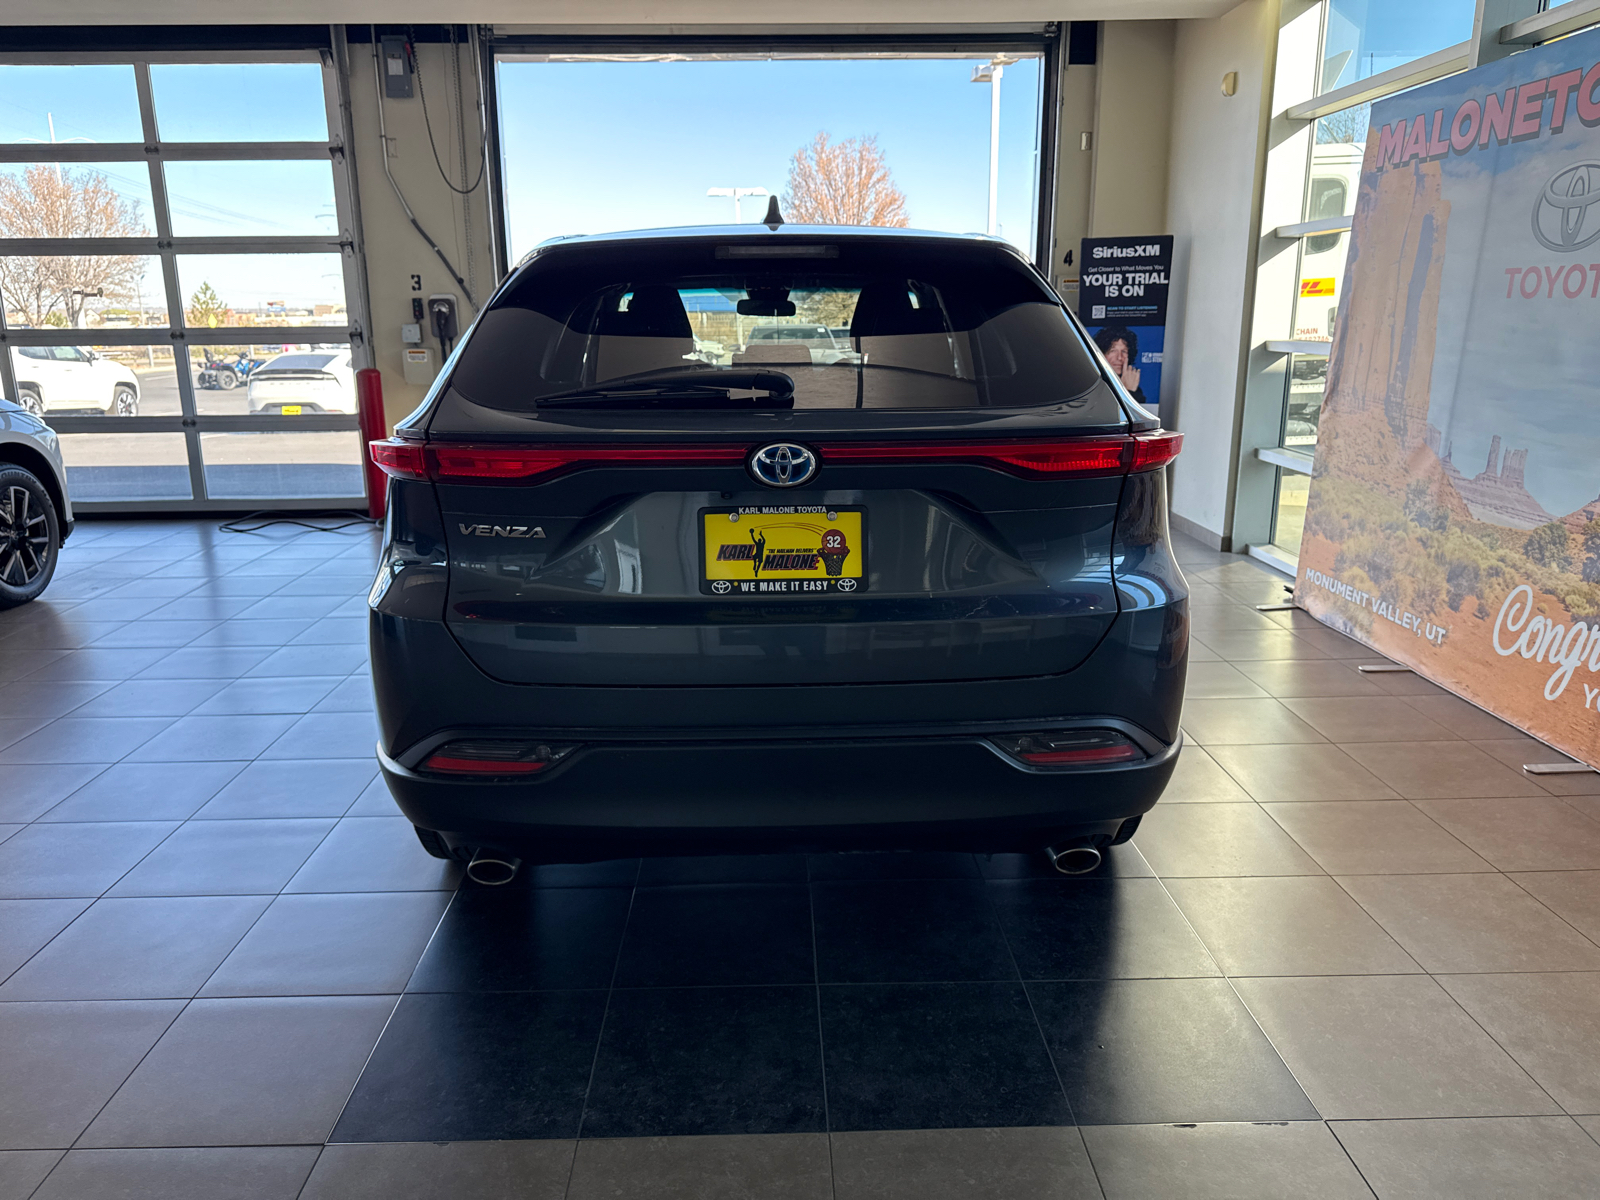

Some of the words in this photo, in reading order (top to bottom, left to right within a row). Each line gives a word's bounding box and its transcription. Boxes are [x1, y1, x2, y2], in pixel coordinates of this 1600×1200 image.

[1063, 249, 1073, 267] 4
[1092, 244, 1160, 259] SiriusXM
[411, 274, 422, 291] 3
[1082, 273, 1122, 287] YOUR
[1125, 272, 1168, 285] TRIAL
[1504, 263, 1600, 300] TOYOT
[1105, 285, 1119, 297] IS
[1121, 285, 1144, 297] ON
[1296, 328, 1318, 336] CHAIN
[738, 507, 760, 515] KARL
[762, 506, 796, 514] MALONE
[458, 523, 547, 538] VENZA
[826, 535, 841, 548] 32
[716, 544, 756, 561] KARL
[761, 553, 820, 571] MALONE
[741, 582, 755, 592] WE
[760, 581, 787, 592] MAKE
[791, 581, 800, 591] IT
[803, 580, 829, 591] EASY
[1305, 567, 1369, 608] MONUMENT
[1371, 597, 1421, 638] VALLEY,
[1425, 622, 1446, 645] UT
